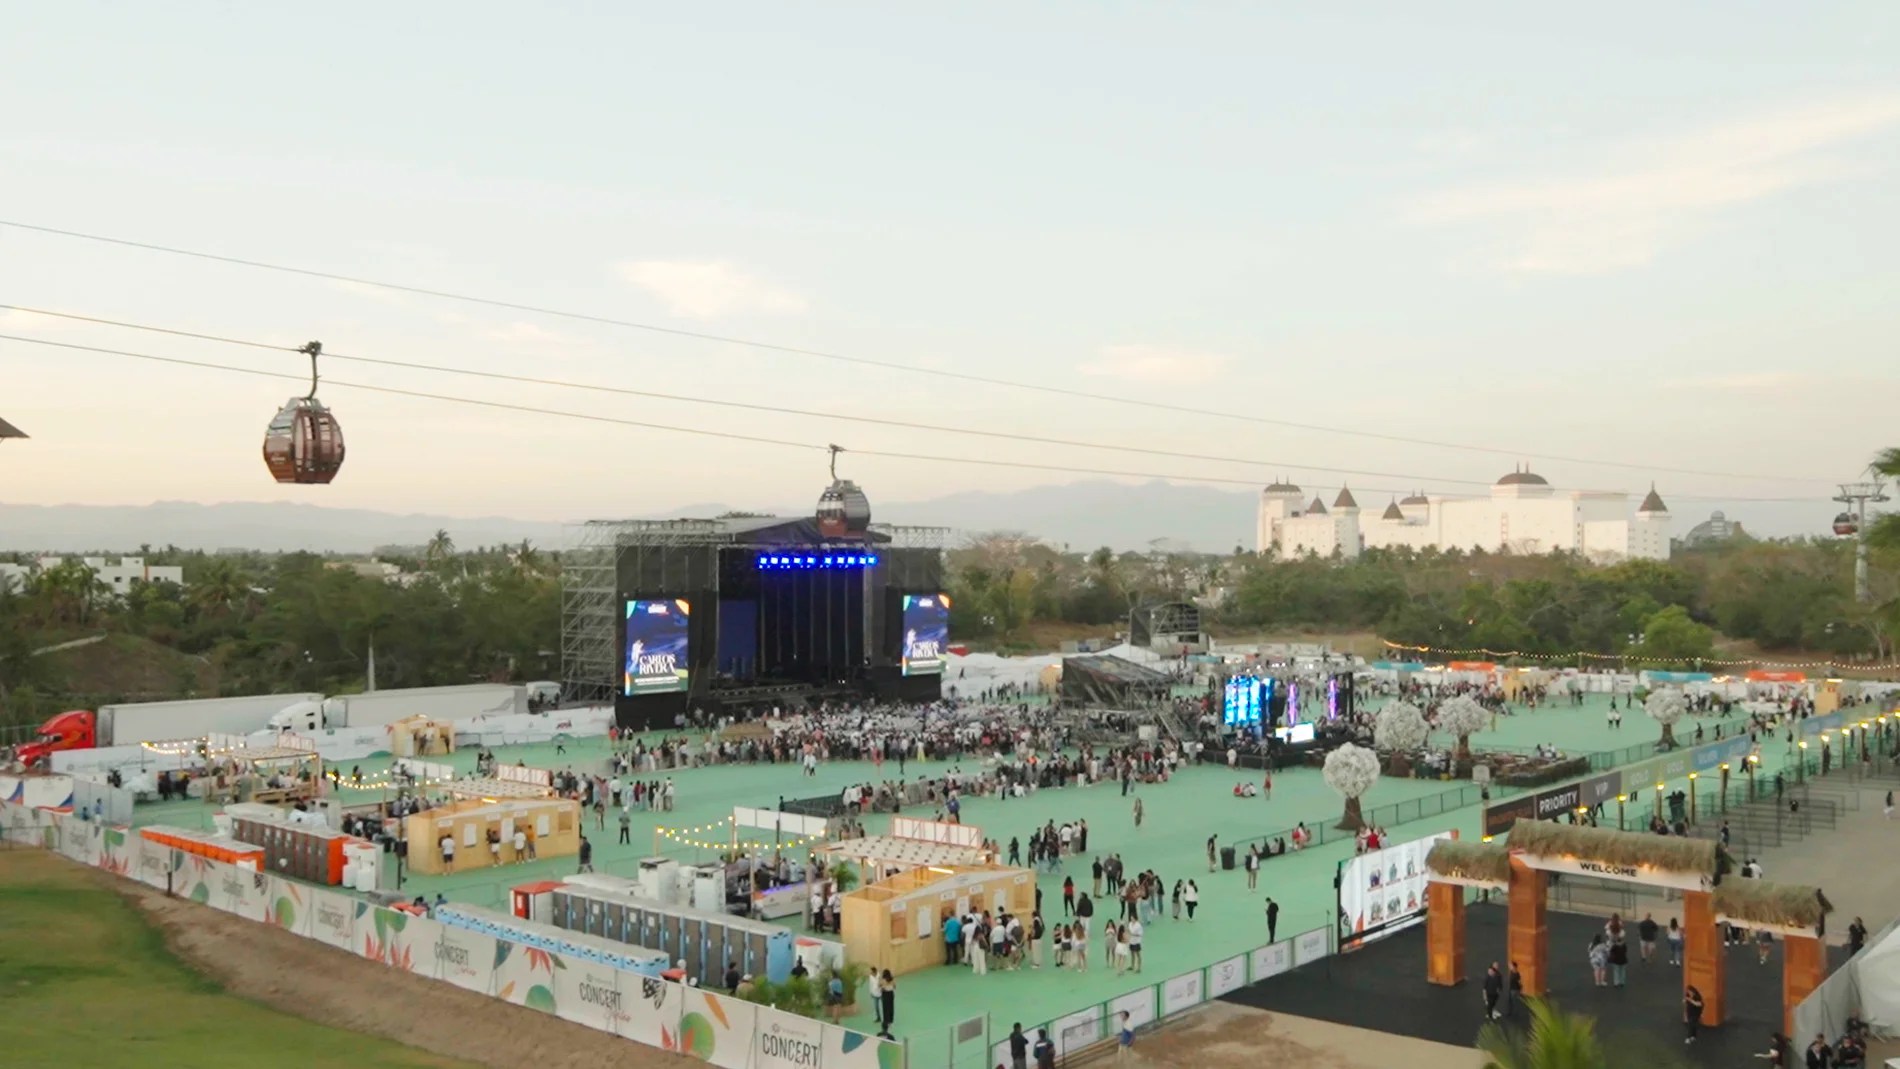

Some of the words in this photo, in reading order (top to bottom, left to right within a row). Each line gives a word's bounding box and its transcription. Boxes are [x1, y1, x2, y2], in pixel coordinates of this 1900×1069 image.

[640, 654, 676, 665] CARLOS
[1595, 781, 1609, 797] VIP
[1539, 790, 1578, 814] PRIORITY
[1579, 862, 1637, 877] WELCOME
[579, 982, 622, 1011] CONCERT
[762, 1033, 819, 1067] CONCERT
